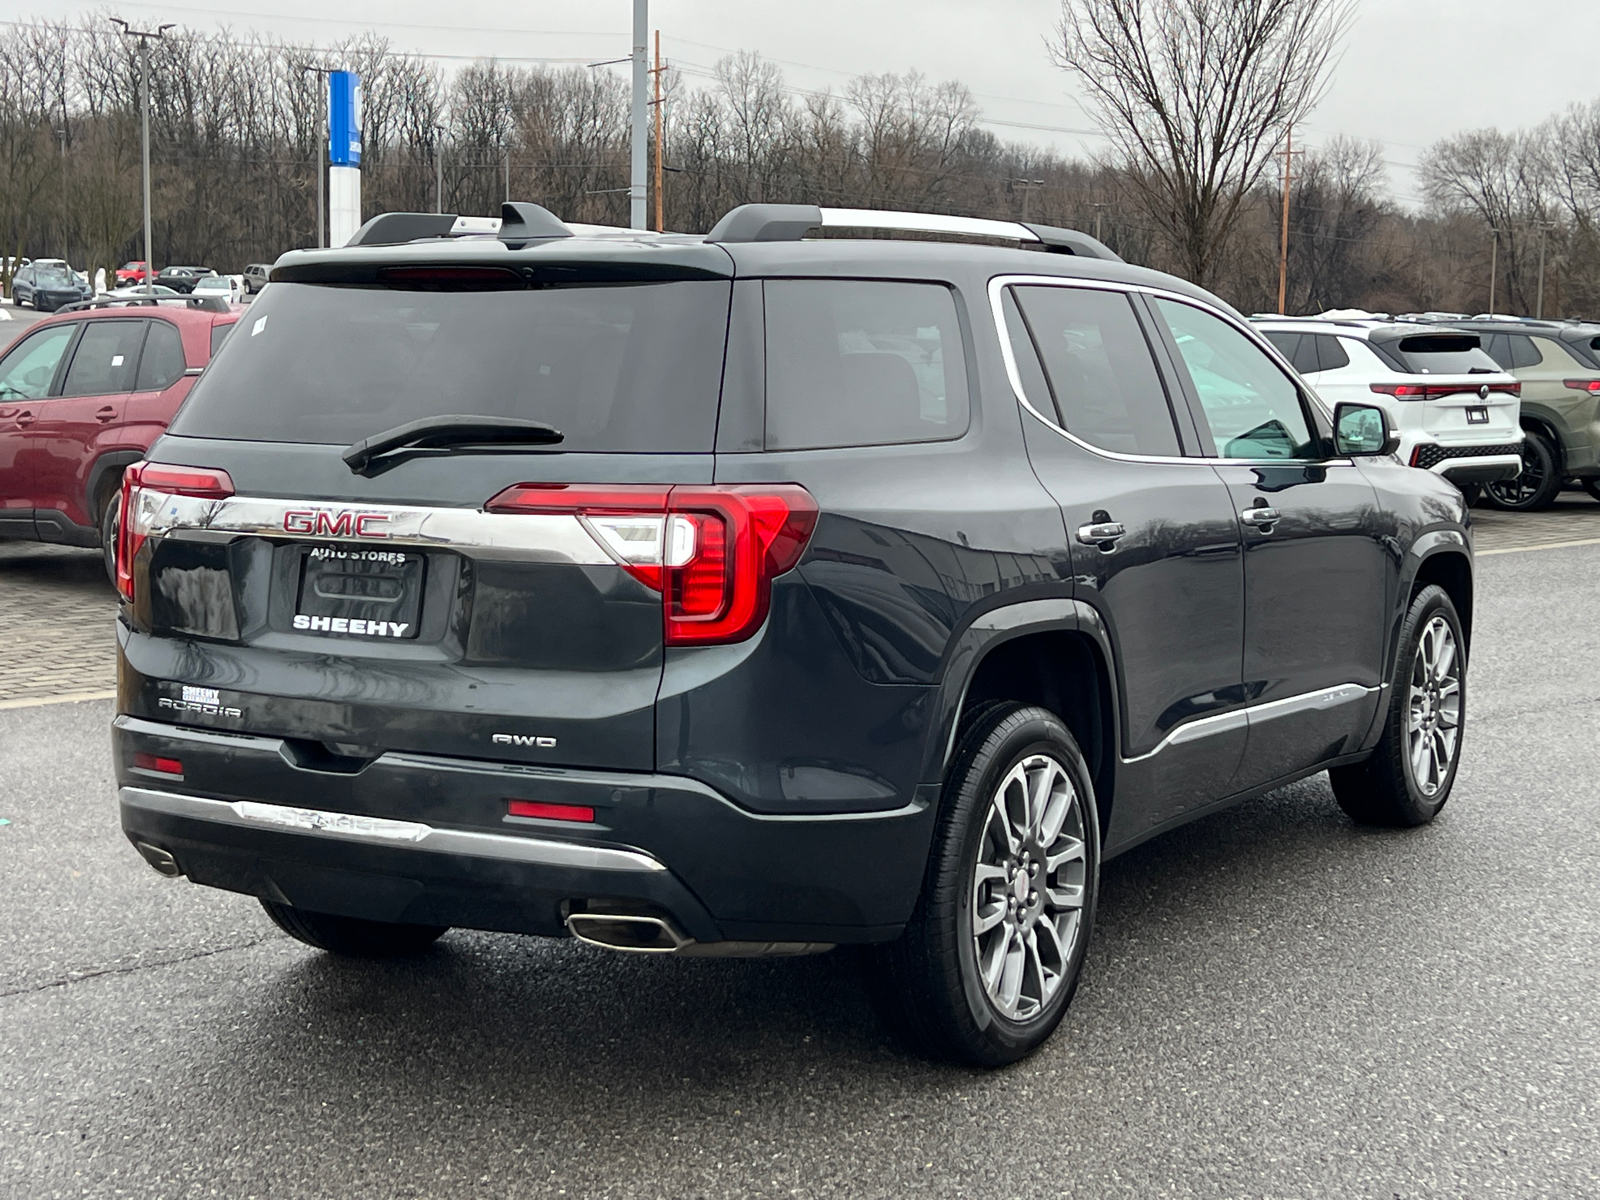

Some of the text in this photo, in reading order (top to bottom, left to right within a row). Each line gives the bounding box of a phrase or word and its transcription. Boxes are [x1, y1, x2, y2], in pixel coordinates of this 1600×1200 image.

[283, 510, 393, 538] GMC
[310, 548, 406, 563] AUTO STORES
[293, 614, 409, 638] SHEEHY
[158, 697, 243, 718] ACADIA
[492, 733, 557, 747] AWD
